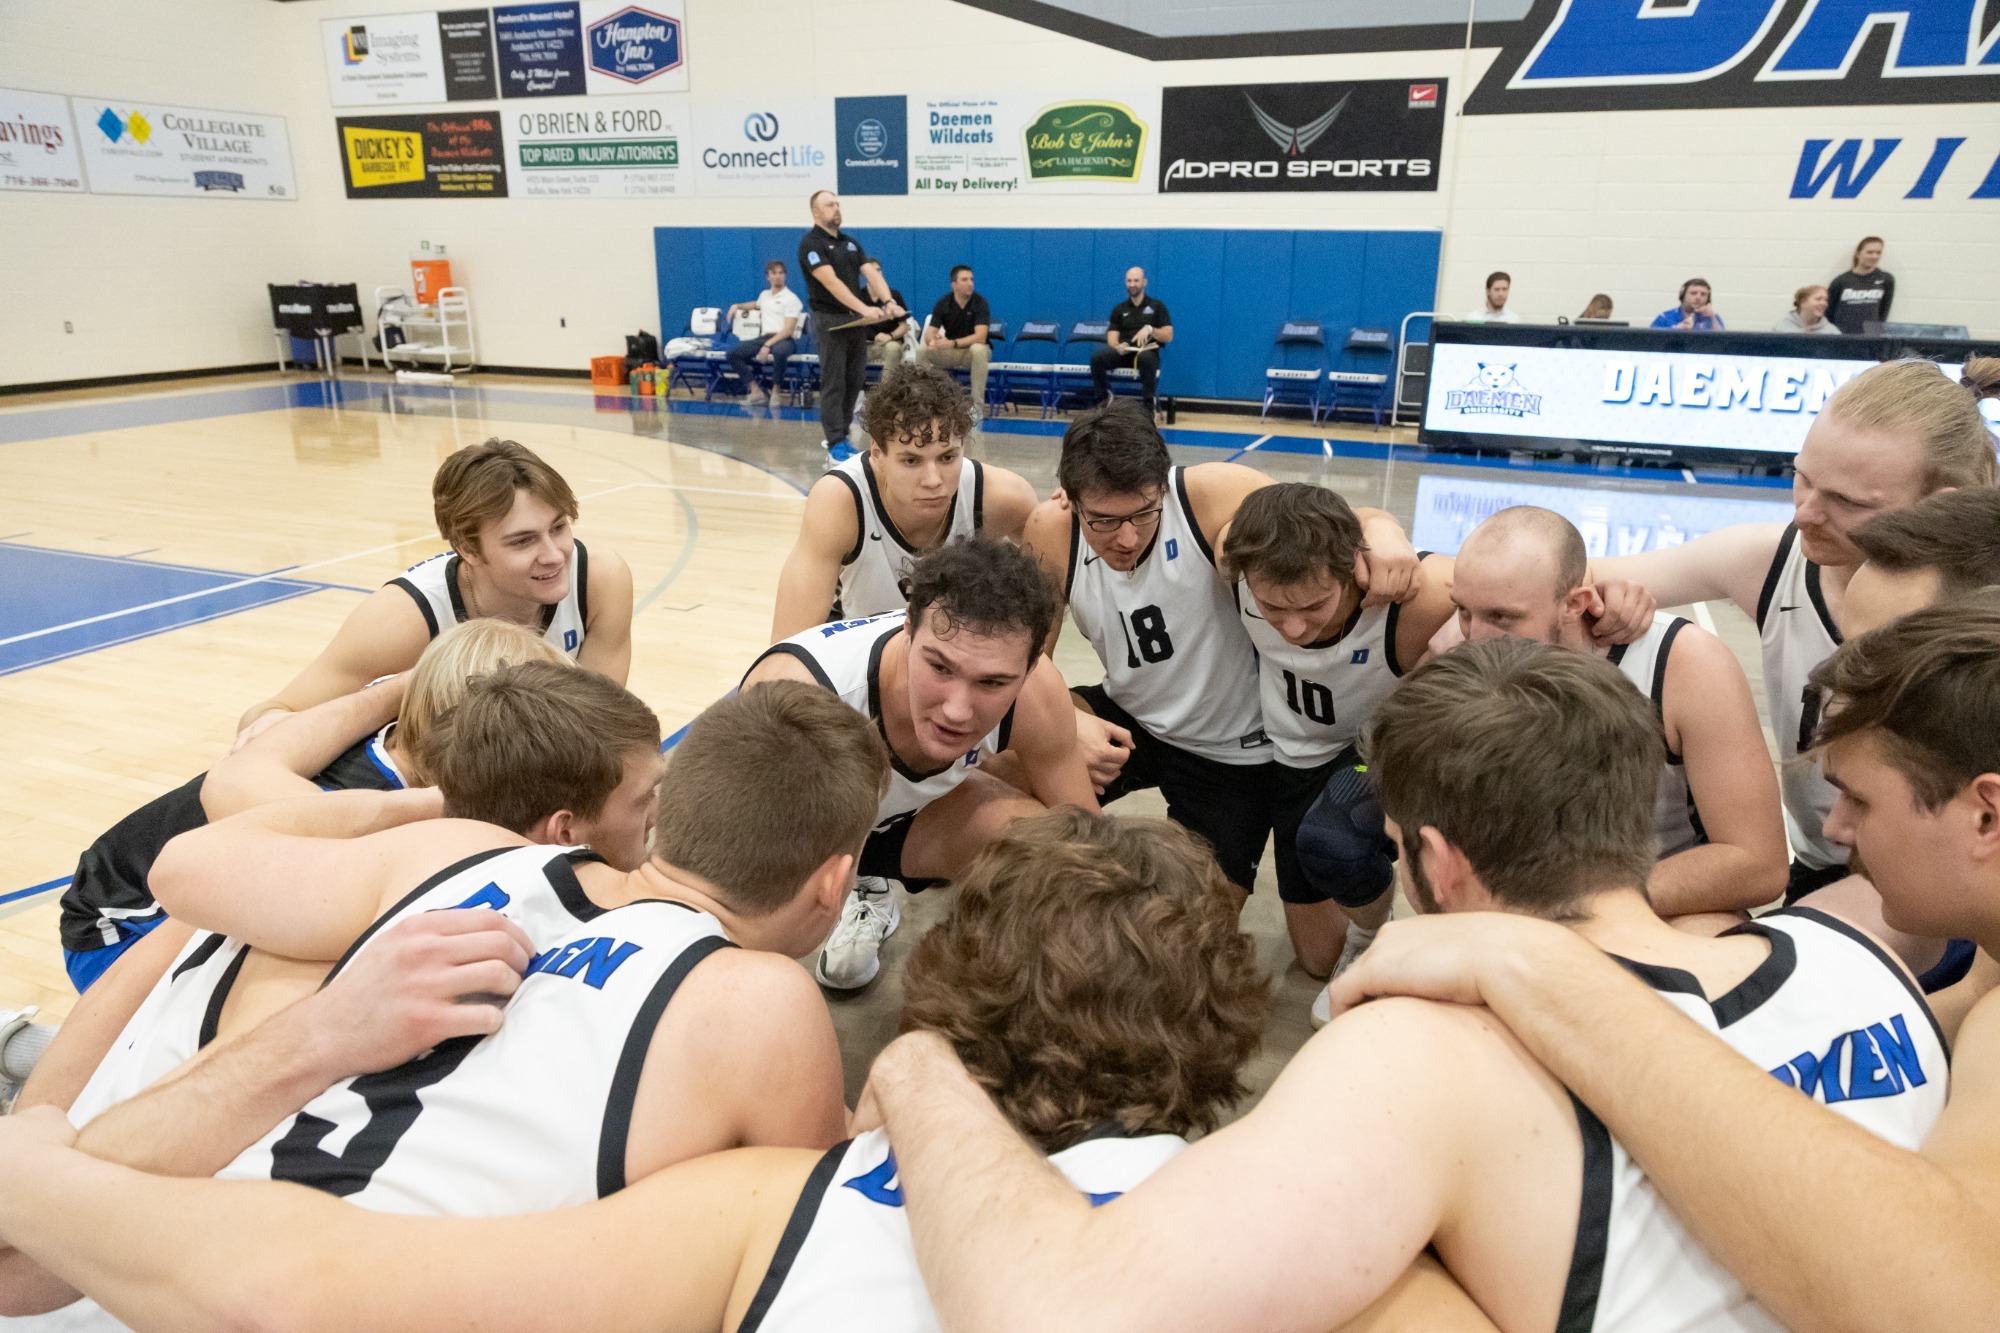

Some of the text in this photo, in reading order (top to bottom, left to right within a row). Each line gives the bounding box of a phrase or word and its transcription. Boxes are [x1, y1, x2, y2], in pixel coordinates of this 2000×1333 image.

[370, 30, 419, 49] Imaging
[597, 22, 672, 48] Hampton
[376, 50, 421, 65] Systems
[615, 42, 653, 65] Inn
[625, 63, 655, 72] HILTON
[519, 112, 590, 135] O'BRIEN
[595, 111, 608, 133] &
[612, 110, 662, 132] FORD
[930, 112, 992, 126] Daemen
[354, 136, 415, 159] DICKEY'S
[929, 129, 994, 144] Wildcats
[1031, 132, 1134, 154] Bob & John's
[522, 145, 676, 162] TOP RATED INJURY ATTORNEYS
[915, 177, 1018, 192] All Day Delivery!
[1164, 159, 1431, 191] ADPRO SPORTS
[1450, 391, 1538, 412] DAEMEN
[1166, 538, 1178, 562] D
[563, 629, 577, 652] D
[1118, 604, 1174, 668] 18
[1283, 669, 1336, 725] 10
